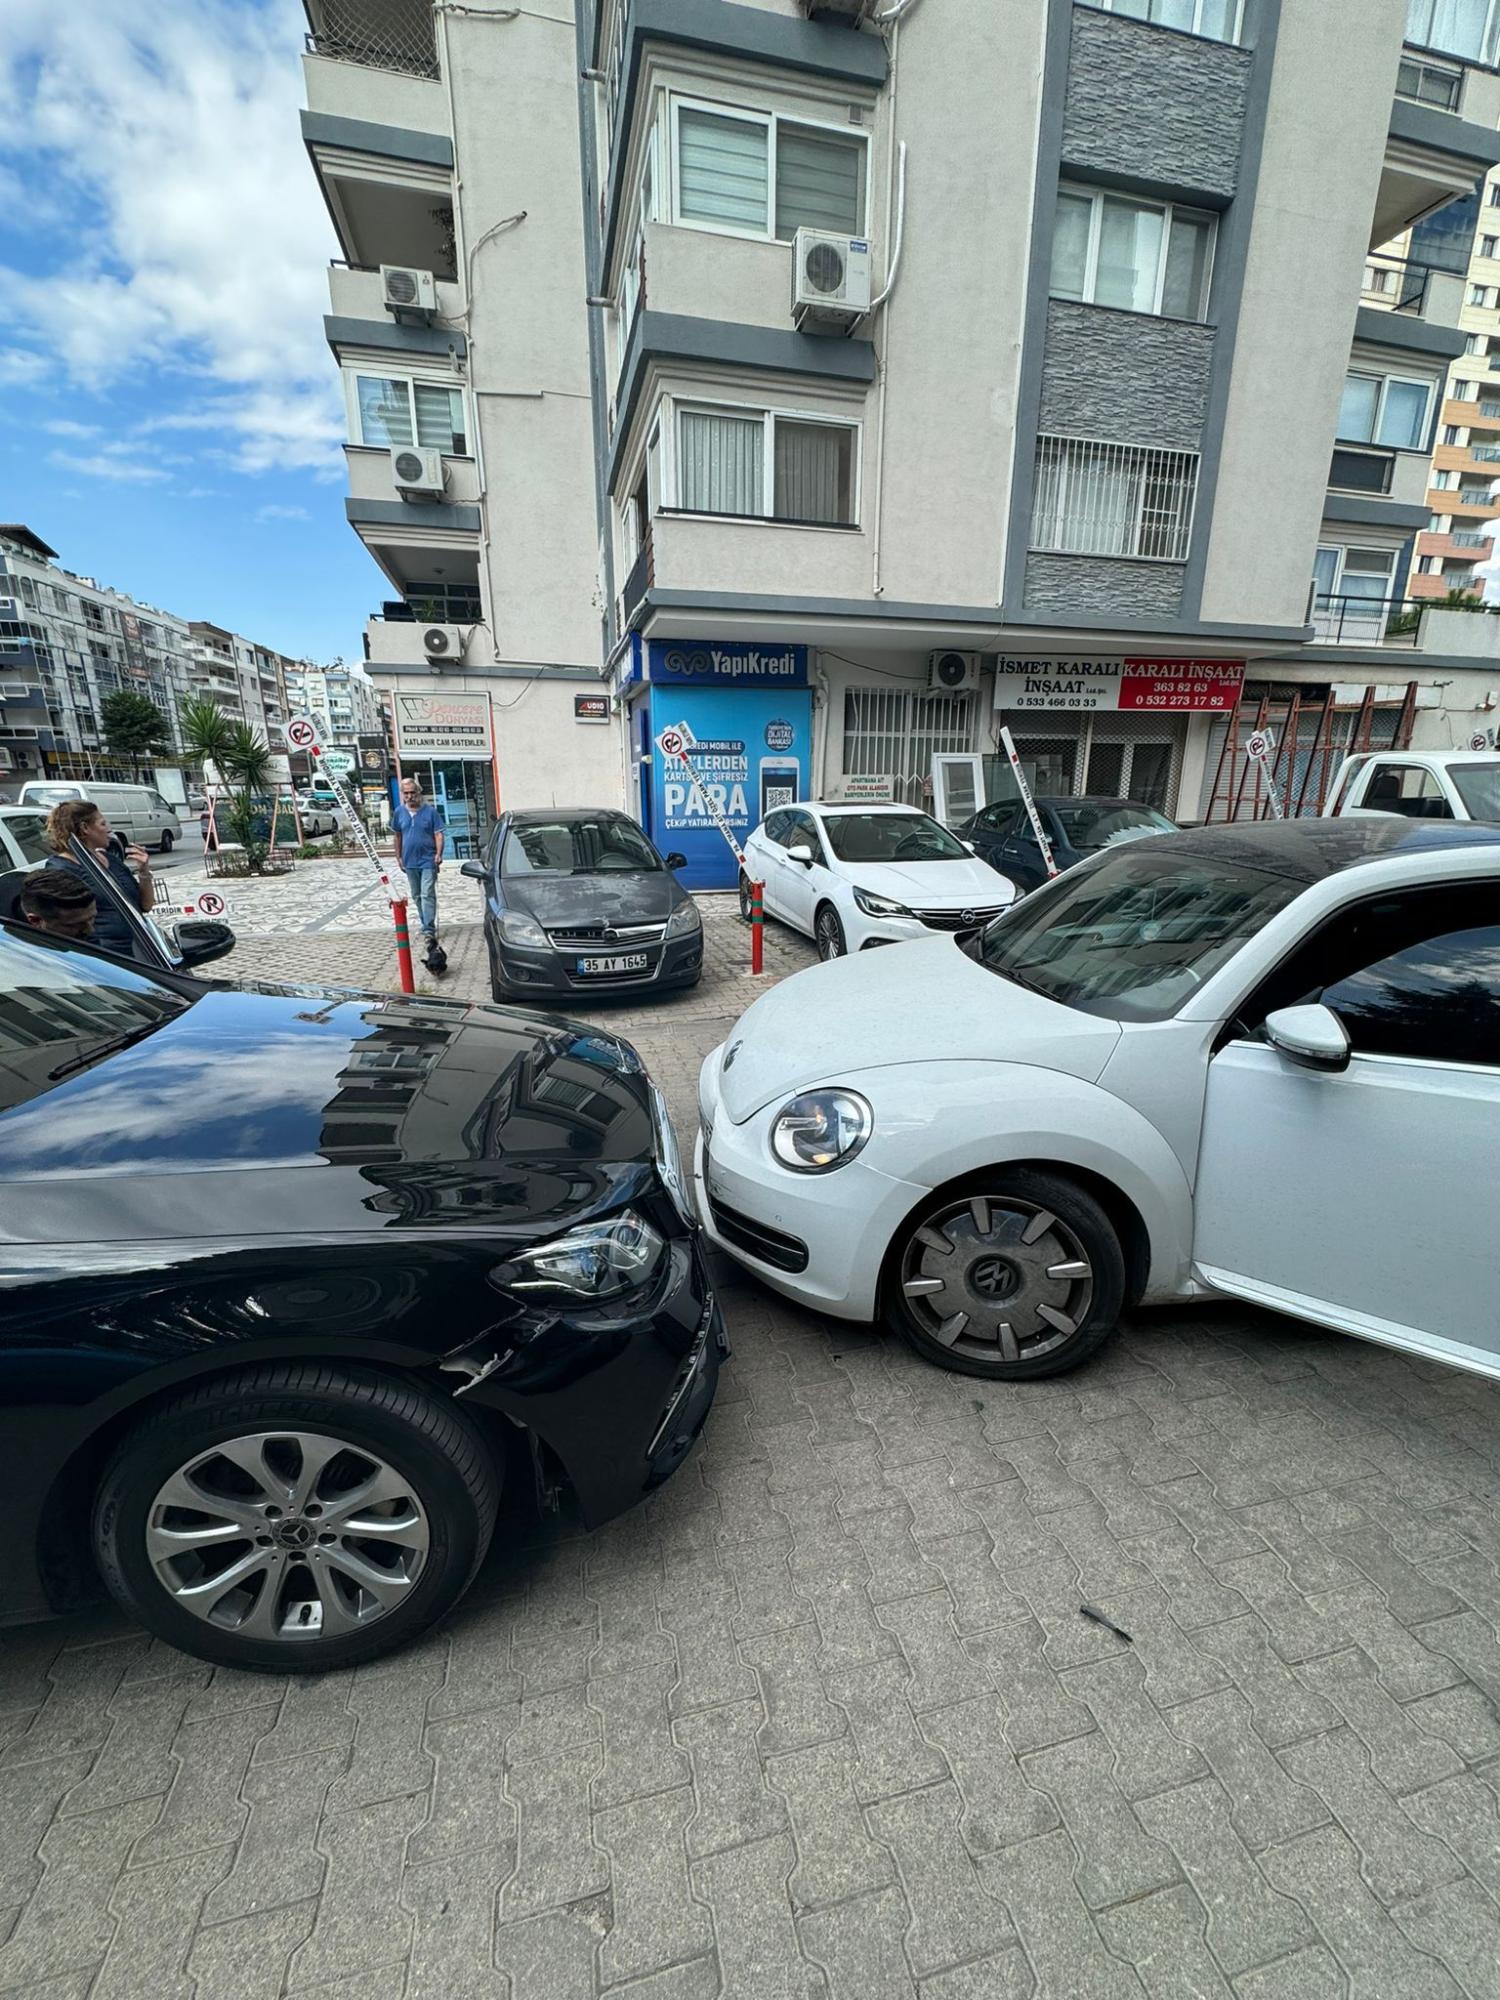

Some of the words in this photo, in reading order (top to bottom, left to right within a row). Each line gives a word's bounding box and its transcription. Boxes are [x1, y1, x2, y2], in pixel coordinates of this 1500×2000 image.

[998, 656, 1052, 675] İSMET
[1056, 662, 1120, 676] KARALI
[1123, 664, 1184, 678] KARALI
[1187, 662, 1245, 682] İNŞAAT
[1024, 676, 1085, 696] İNŞAAT
[1154, 682, 1175, 693] 363
[1177, 683, 1191, 693] 82
[1194, 683, 1208, 693] 63
[1017, 698, 1024, 706] 0
[1026, 698, 1045, 706] 533
[1048, 699, 1066, 707] 466
[1068, 699, 1081, 707] 03
[1083, 699, 1097, 707] 33
[1136, 695, 1144, 705] 0
[1146, 696, 1167, 705] 532
[1170, 696, 1190, 705] 273
[1194, 696, 1207, 706] 17
[1210, 696, 1224, 706] 82
[333, 785, 347, 804] PARK
[665, 784, 749, 816] PARA
[585, 959, 599, 971] 35
[604, 958, 618, 970] AY
[622, 955, 646, 968] 1645
